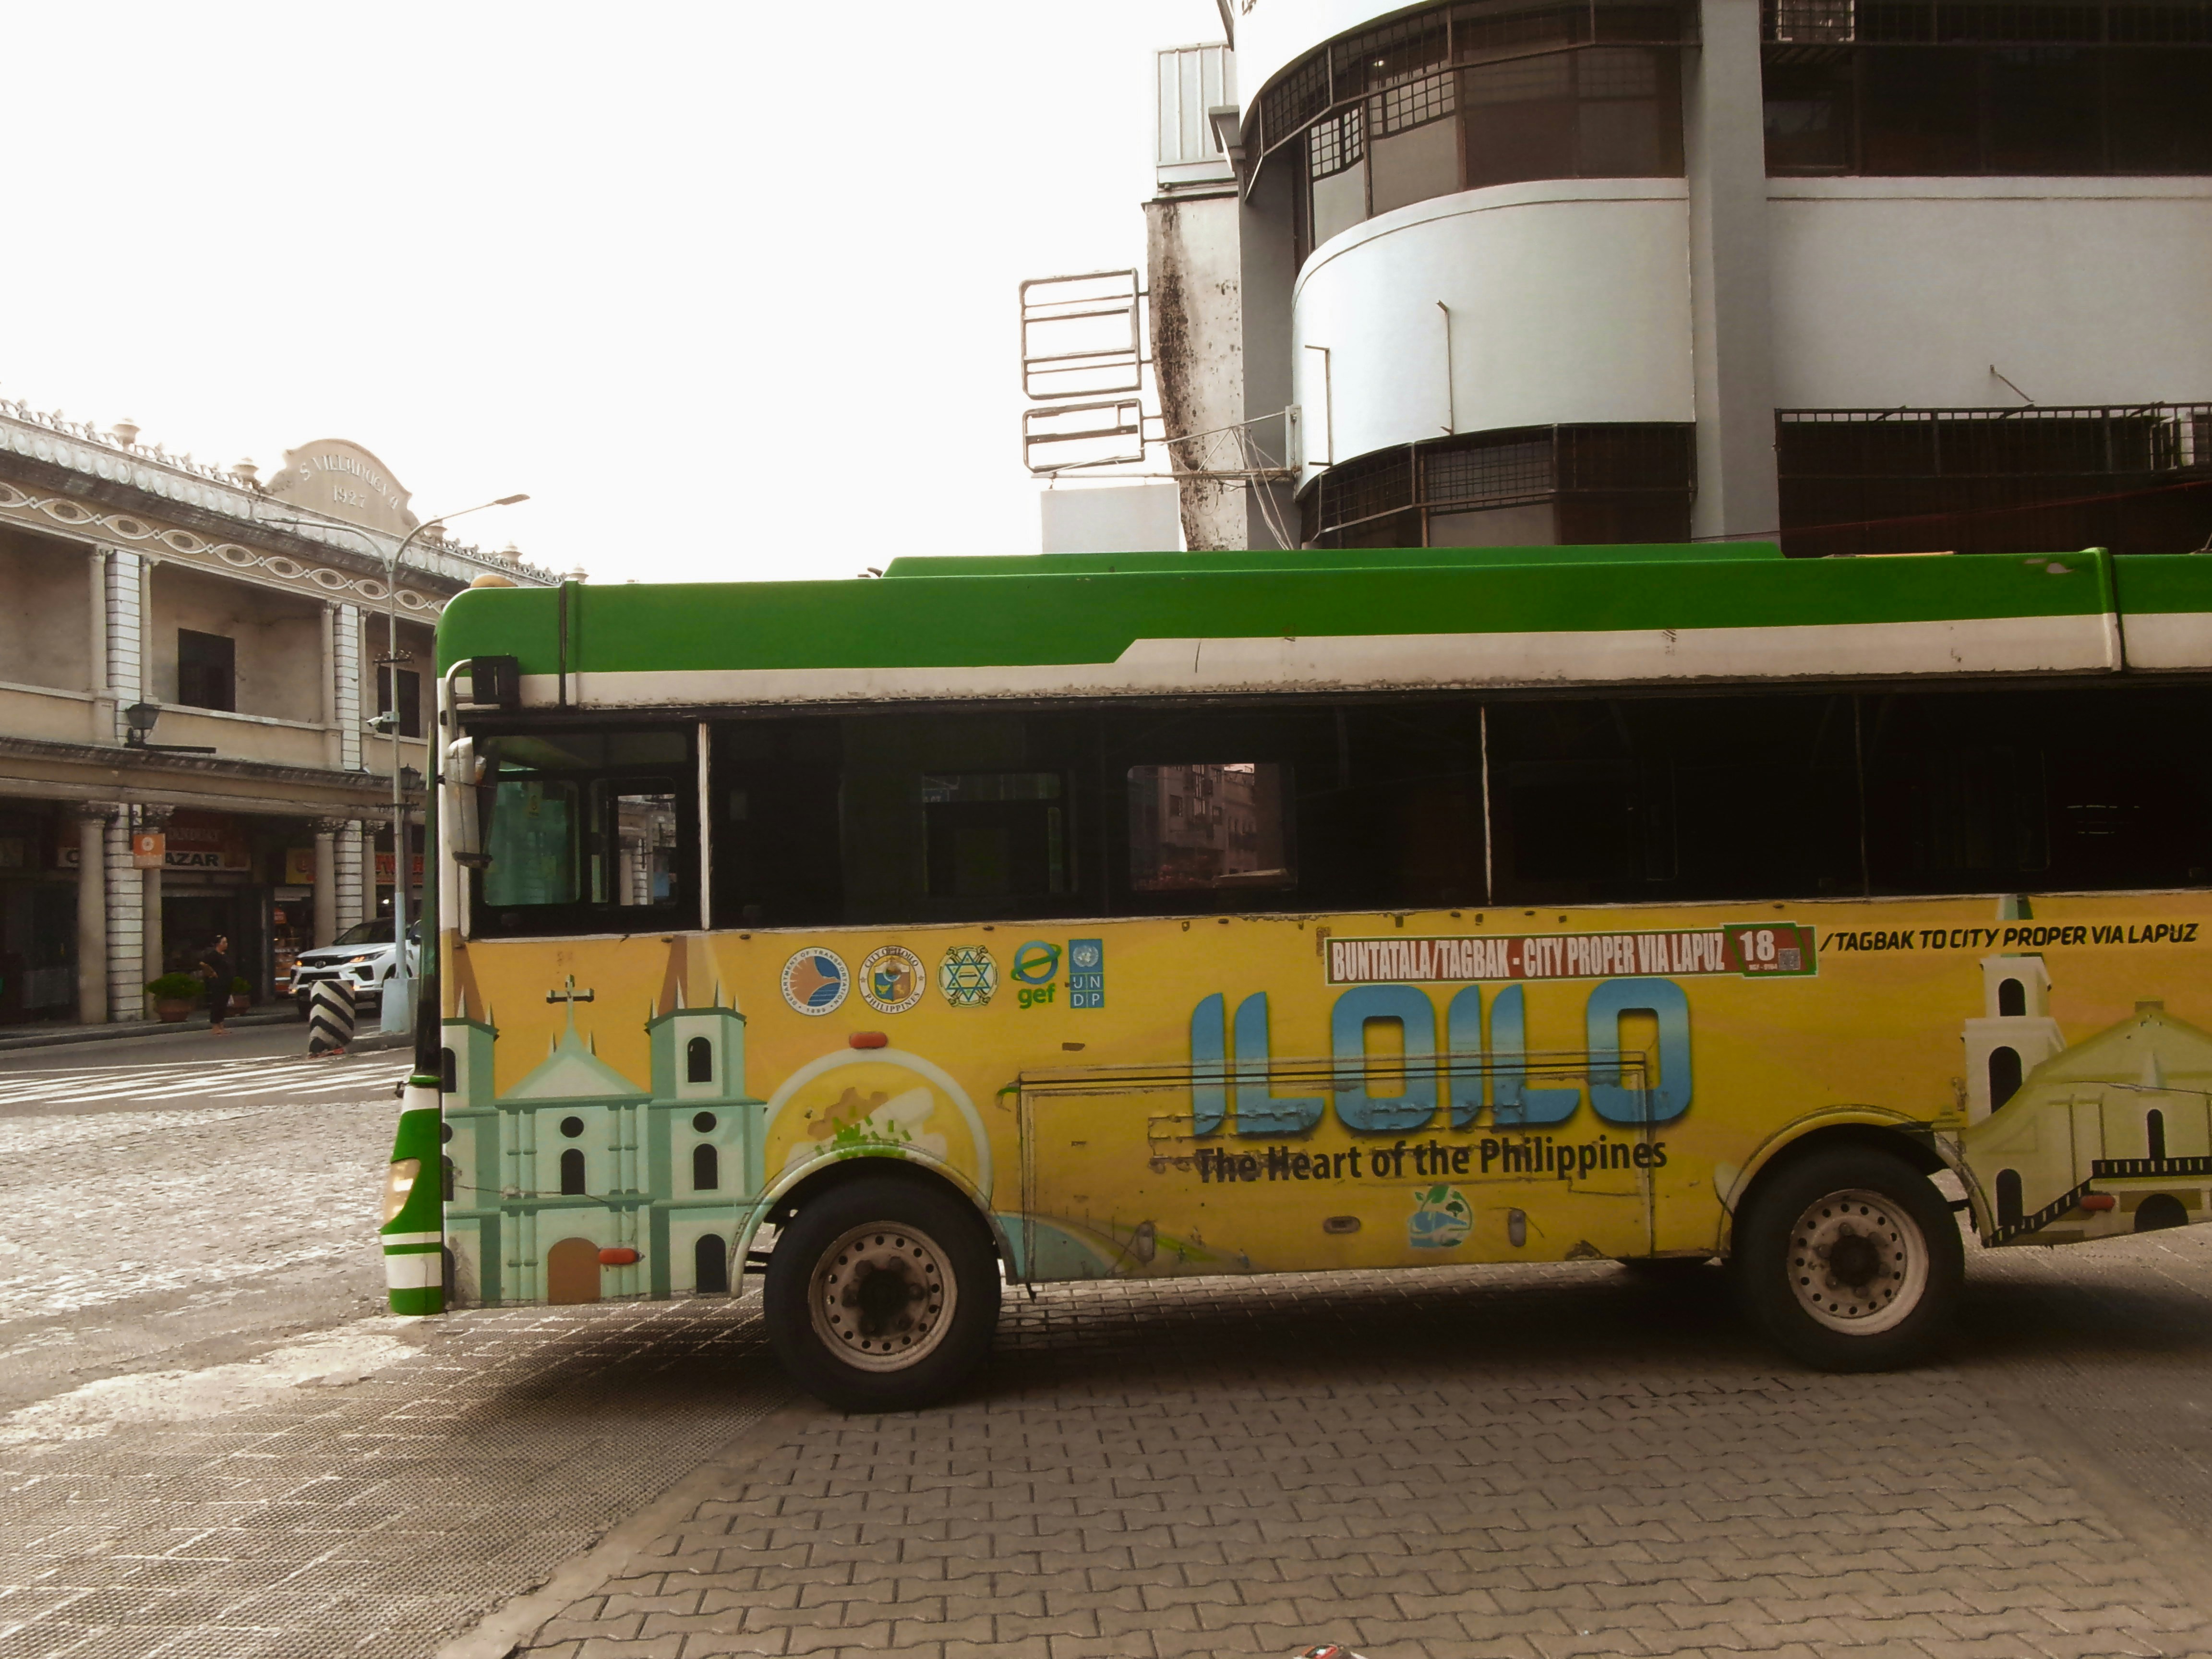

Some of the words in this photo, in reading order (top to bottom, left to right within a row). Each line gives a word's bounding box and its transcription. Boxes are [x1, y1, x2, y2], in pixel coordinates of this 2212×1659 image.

[333, 485, 365, 509] 1927
[166, 852, 219, 867] AZAR
[1740, 930, 1775, 961] 18
[1919, 929, 1947, 949] TO
[1950, 928, 2000, 948] CITY
[2003, 926, 2087, 947] PROPER
[2092, 925, 2124, 945] VIA
[2128, 923, 2200, 944] LAPUZ
[865, 950, 880, 968] CITY
[1332, 939, 1511, 981] BUNTATALA/TAGBAK
[1523, 937, 1563, 977] CITY
[1567, 935, 1635, 975] PROPER
[1637, 934, 1670, 973] VIA
[1671, 932, 1725, 972] LAPUZ
[783, 957, 798, 1006] DEPARTMENT
[814, 950, 847, 1005] TRANSPORTATION
[866, 992, 920, 1012] PHILIPPINES
[1018, 983, 1056, 1010] gef
[1191, 977, 1693, 1135] ILOILO
[1196, 1147, 1257, 1183] The
[1268, 1145, 1362, 1181] Heart
[1371, 1140, 1406, 1177] of
[1416, 1139, 1470, 1176] the
[1480, 1134, 1668, 1180] Philippines
